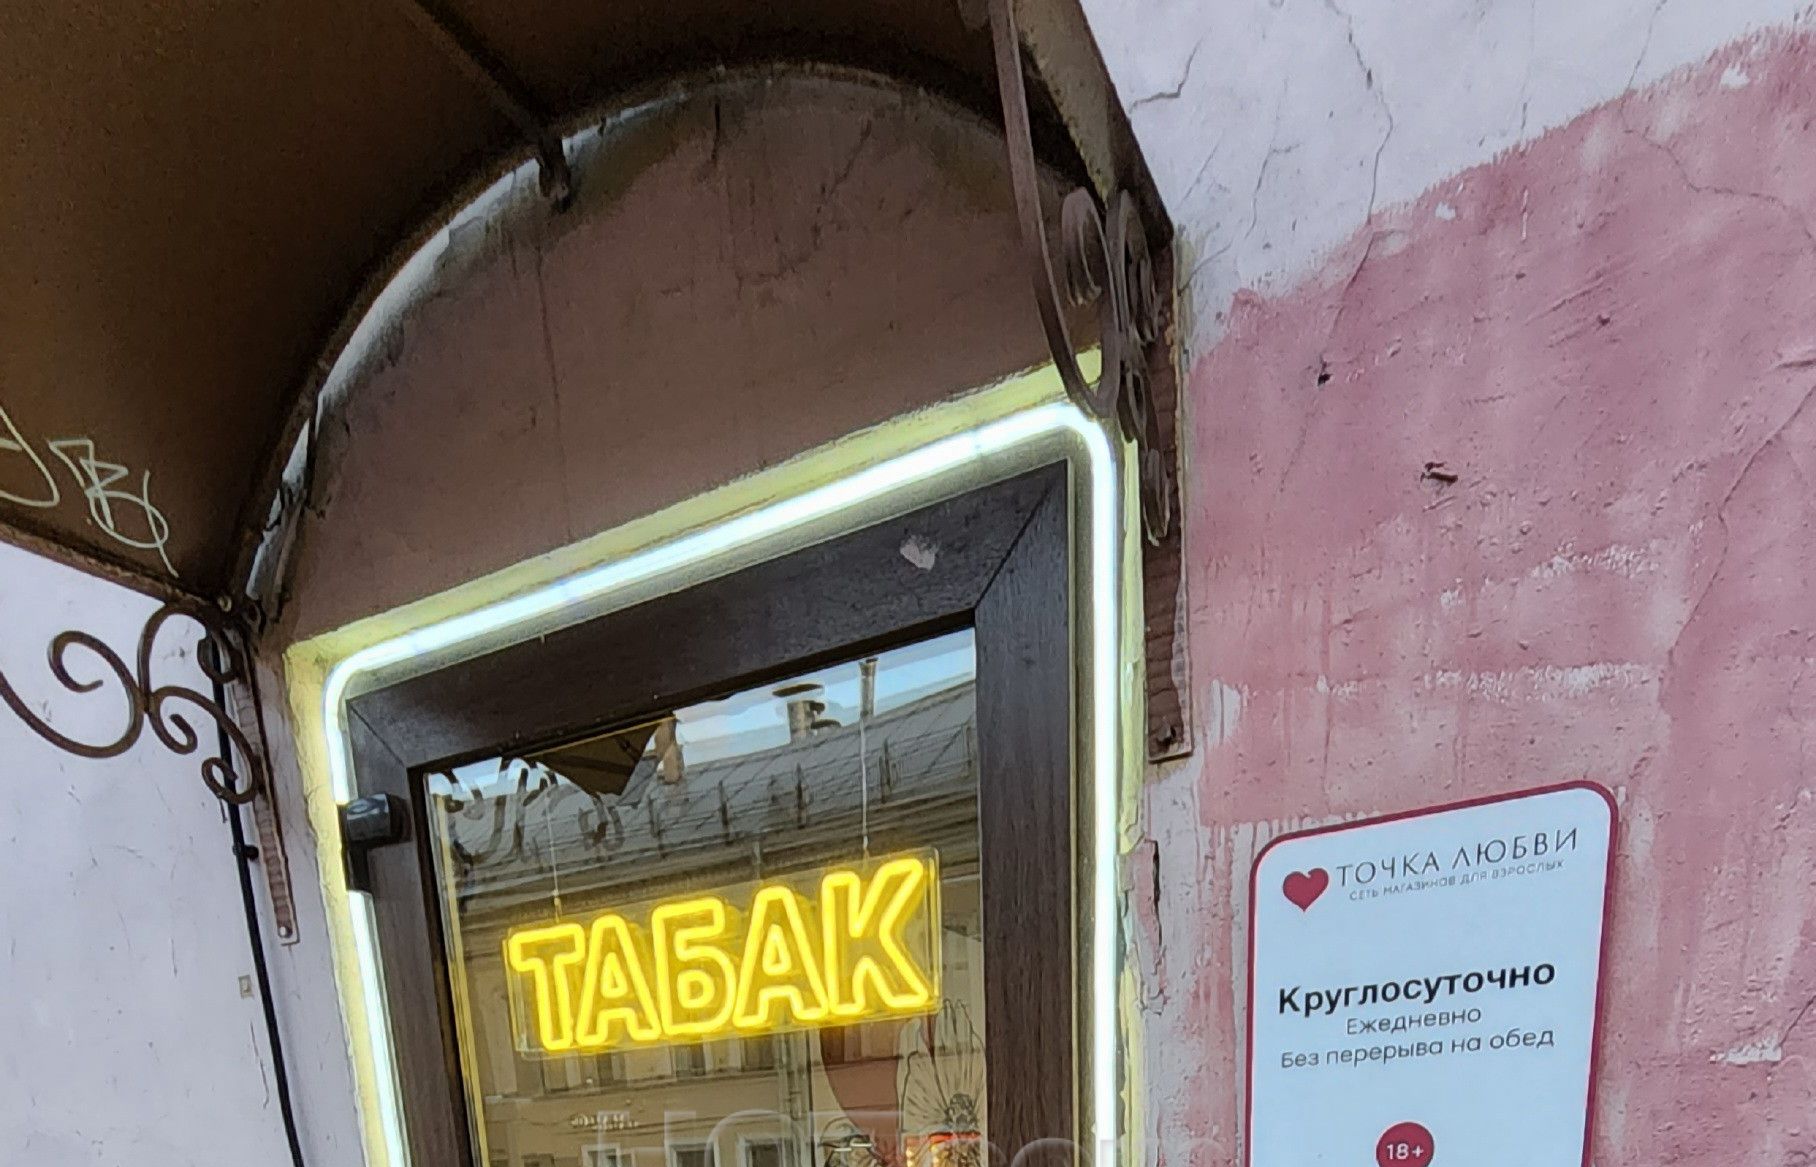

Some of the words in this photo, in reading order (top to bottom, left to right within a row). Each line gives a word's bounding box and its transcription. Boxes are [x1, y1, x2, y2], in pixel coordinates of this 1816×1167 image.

[1336, 852, 1440, 887] ТОЧКА
[1452, 827, 1578, 870] ЛЮБВИ
[1349, 887, 1379, 901] СЕТЬ
[1383, 876, 1456, 897] МАГАЗИНОВ
[1460, 869, 1488, 887] ДЛЯ
[1492, 859, 1565, 881] ВЗРОСЛЫХ
[509, 857, 929, 1053] ТАБАК
[1278, 963, 1555, 1017] Круглосуточно
[1346, 1008, 1482, 1035] Ежедневно
[1281, 1052, 1319, 1068] Без
[1326, 1041, 1443, 1067] перерыва
[1452, 1036, 1481, 1053] на
[1489, 1028, 1555, 1049] обед
[1386, 1142, 1425, 1160] 18+
